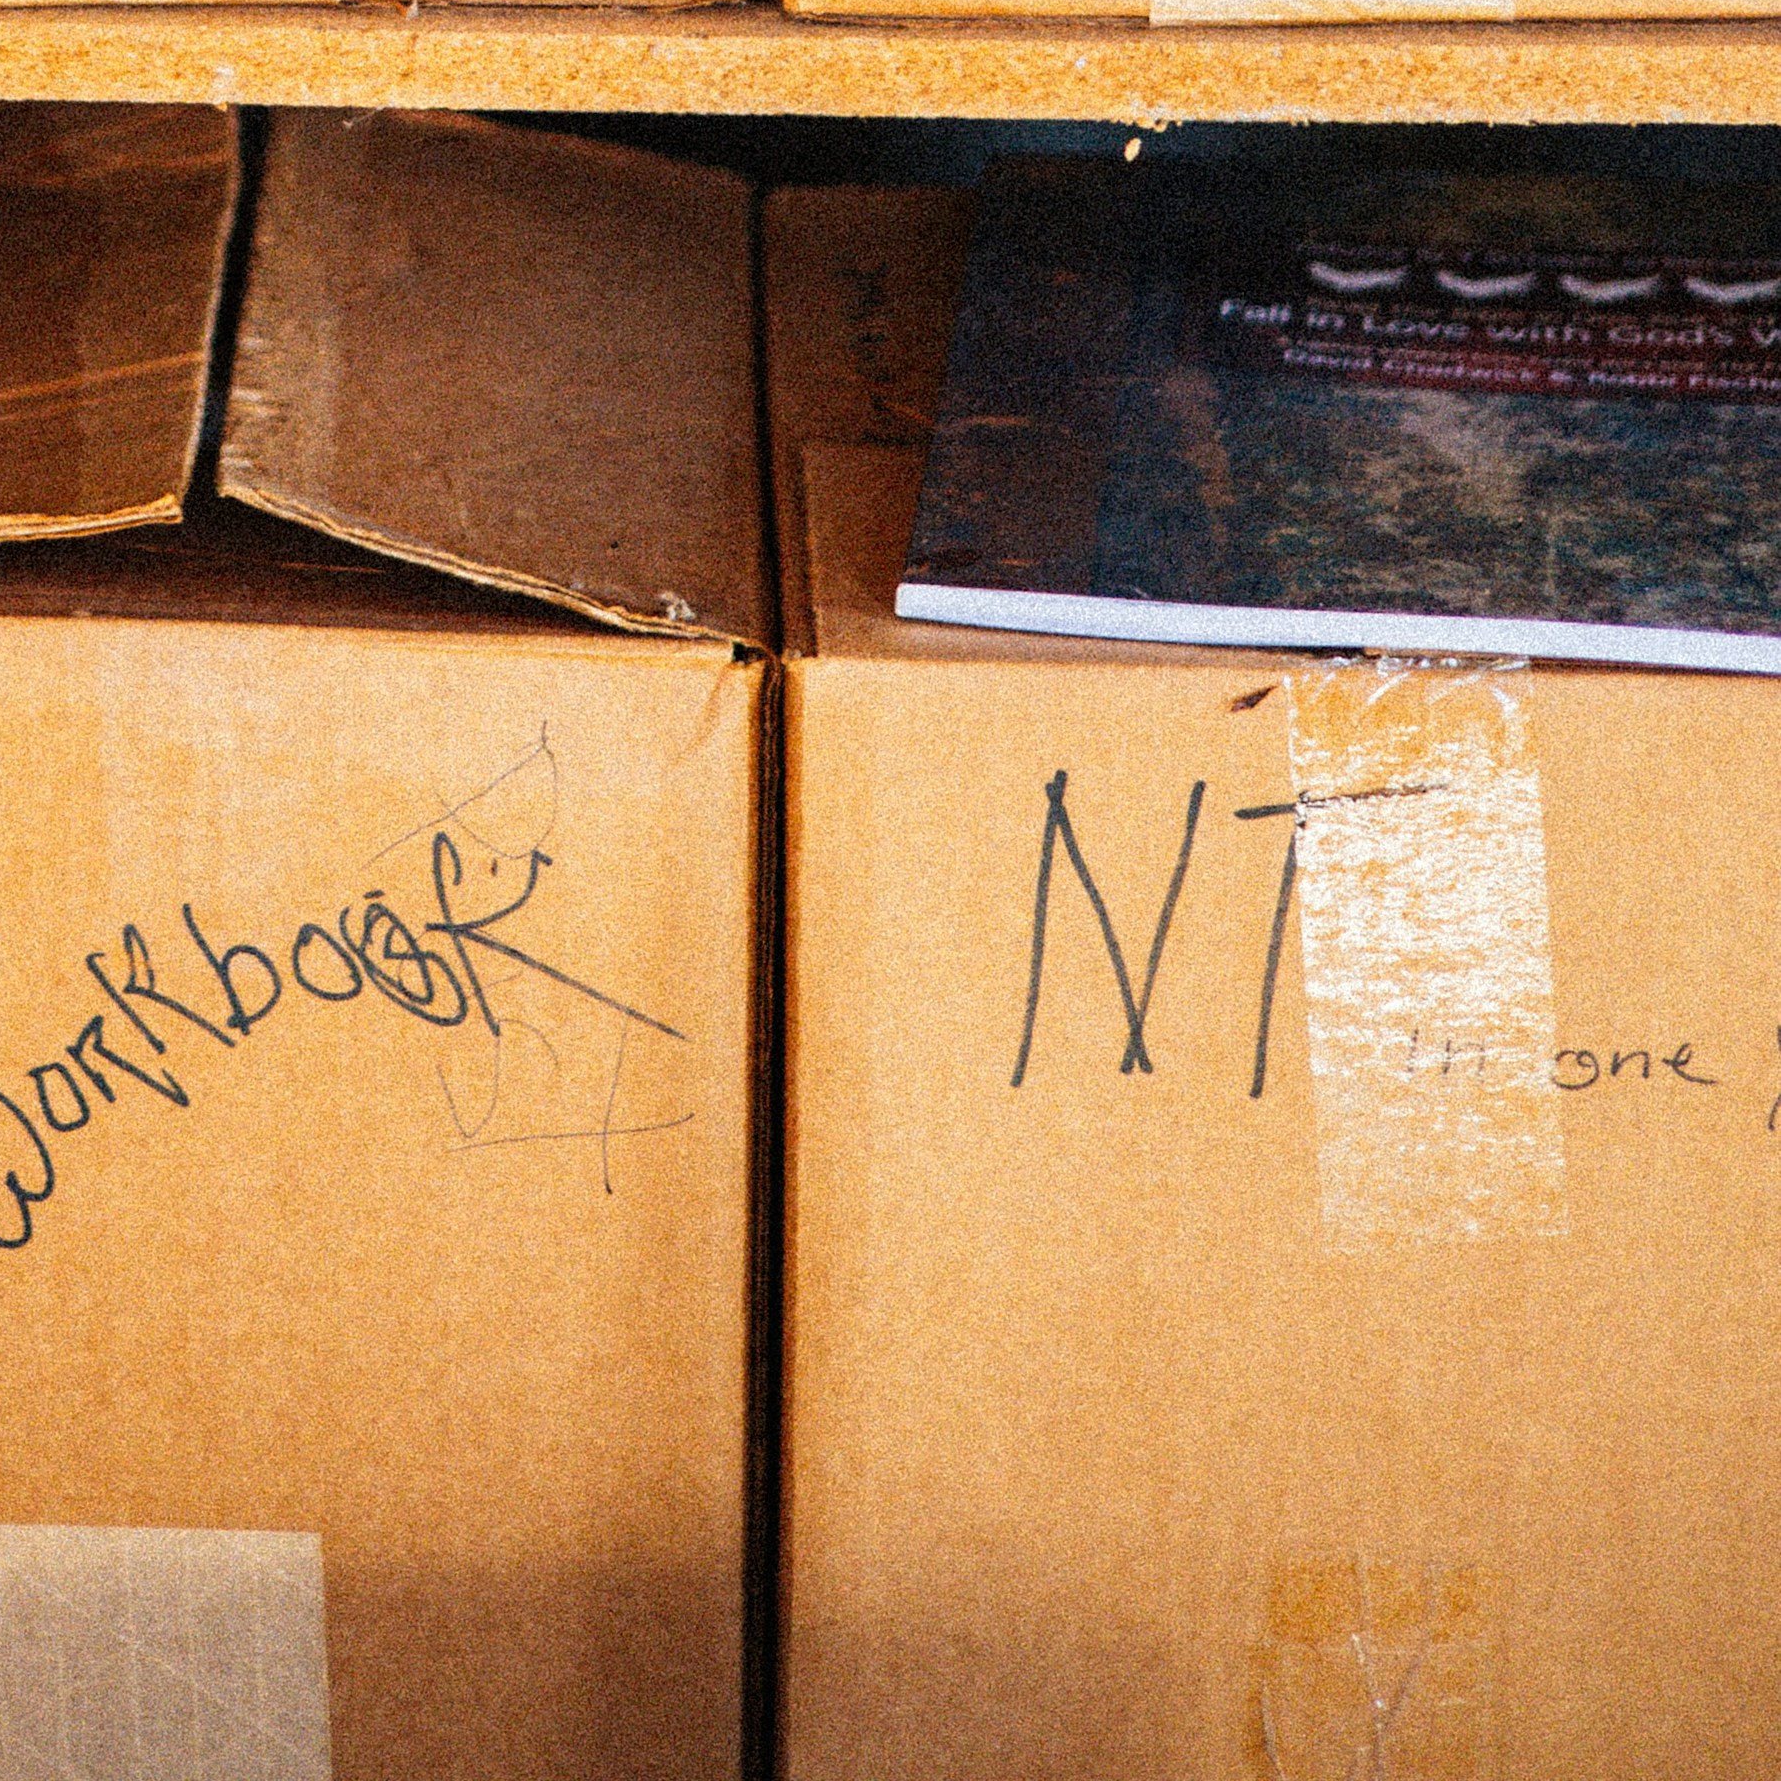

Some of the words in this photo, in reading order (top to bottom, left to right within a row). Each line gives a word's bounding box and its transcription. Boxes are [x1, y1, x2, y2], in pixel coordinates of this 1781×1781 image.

[1362, 314, 1468, 339] Love
[1486, 323, 1590, 341] with
[1011, 769, 1447, 1100] NT
